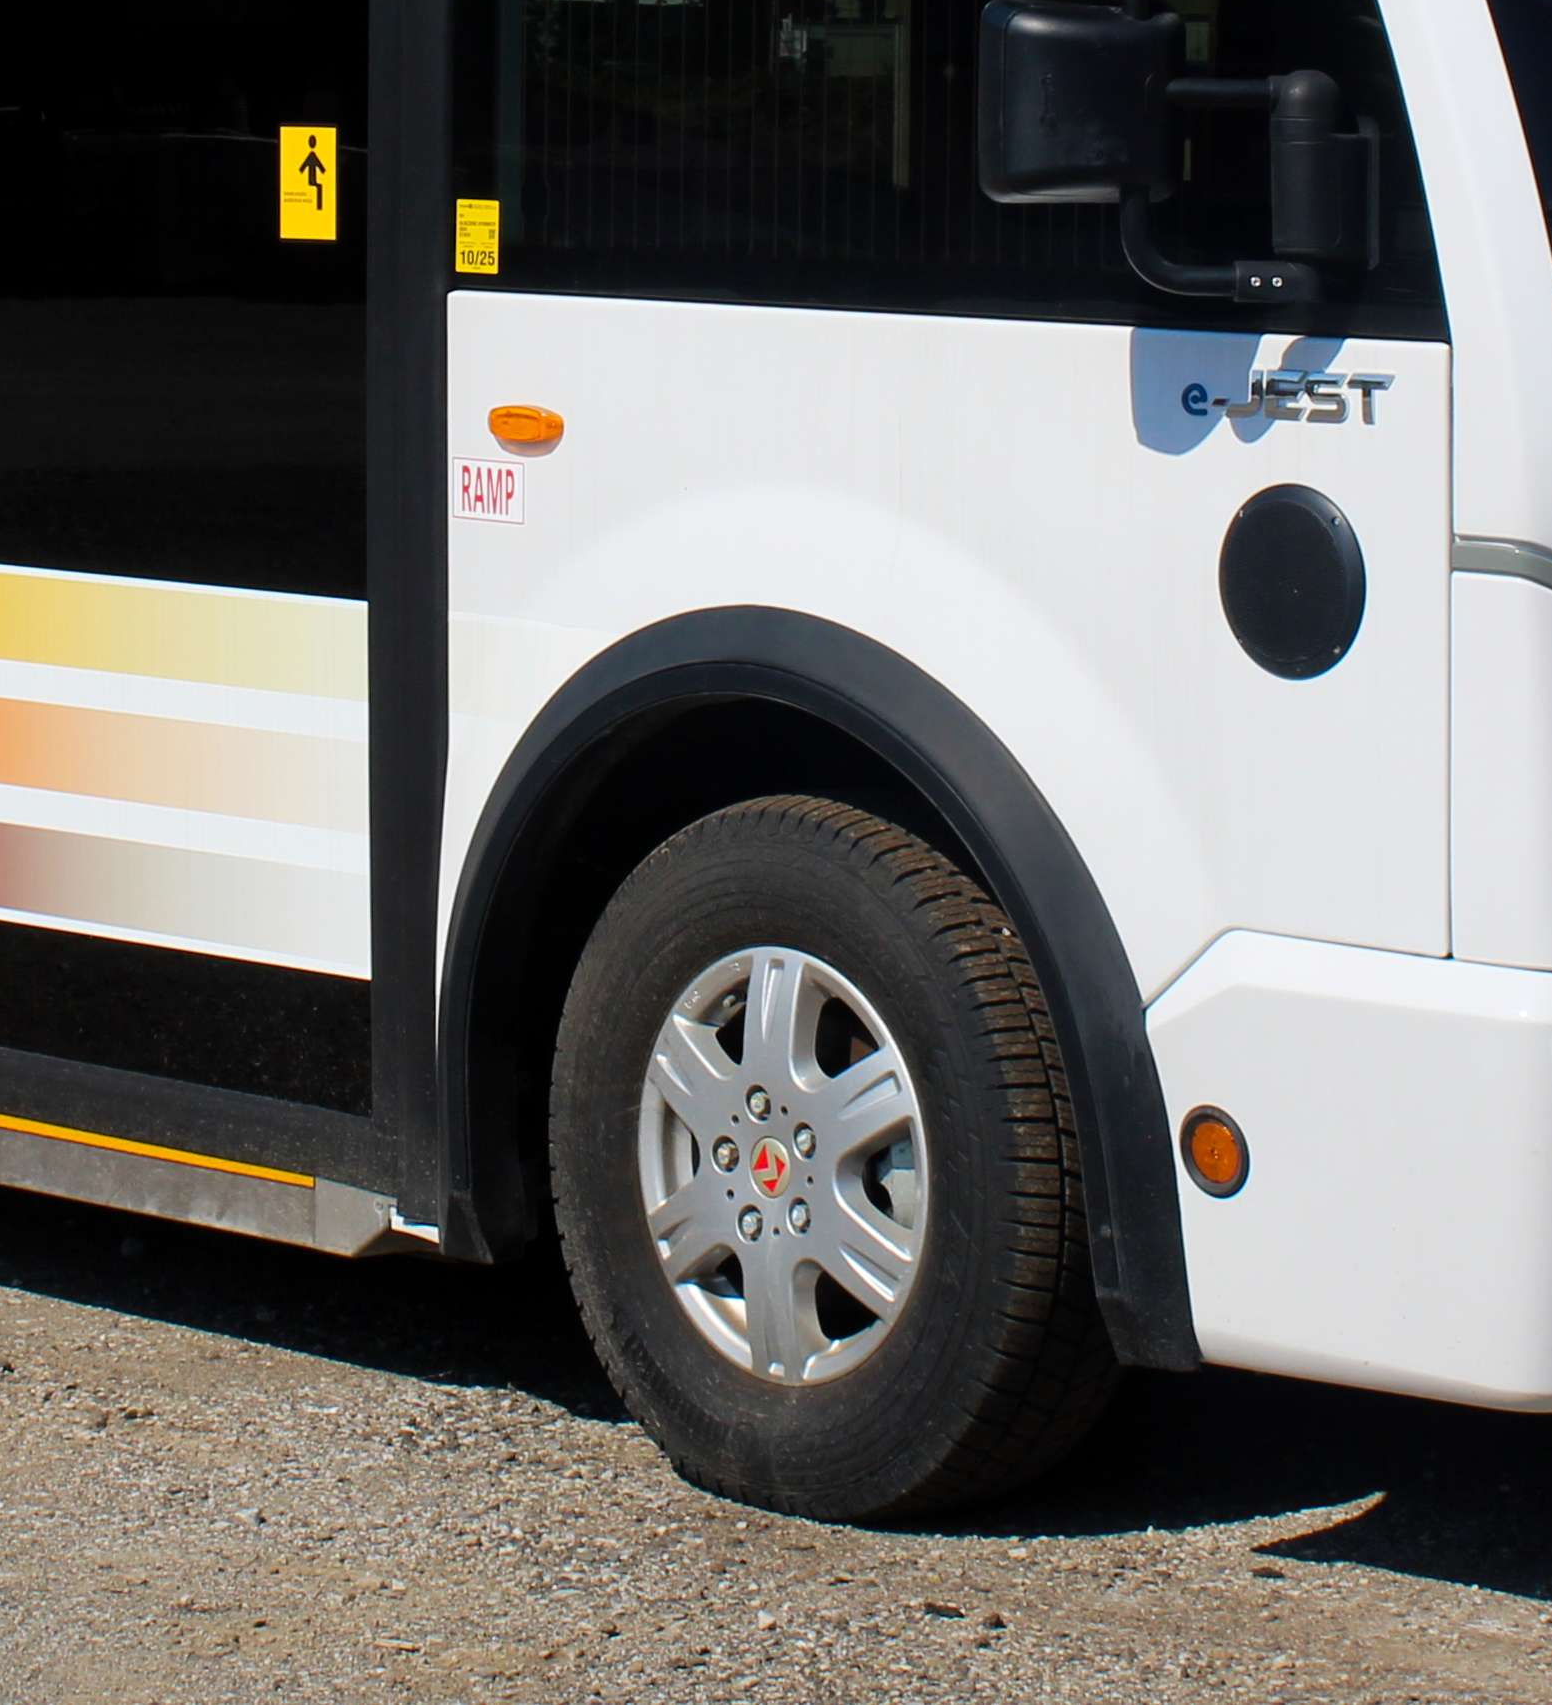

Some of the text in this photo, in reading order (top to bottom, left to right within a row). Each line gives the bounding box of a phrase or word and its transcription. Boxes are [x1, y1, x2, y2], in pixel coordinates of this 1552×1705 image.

[460, 250, 496, 267] 10/25
[1181, 368, 1396, 426] e-JEST
[461, 464, 516, 517] RAMP
